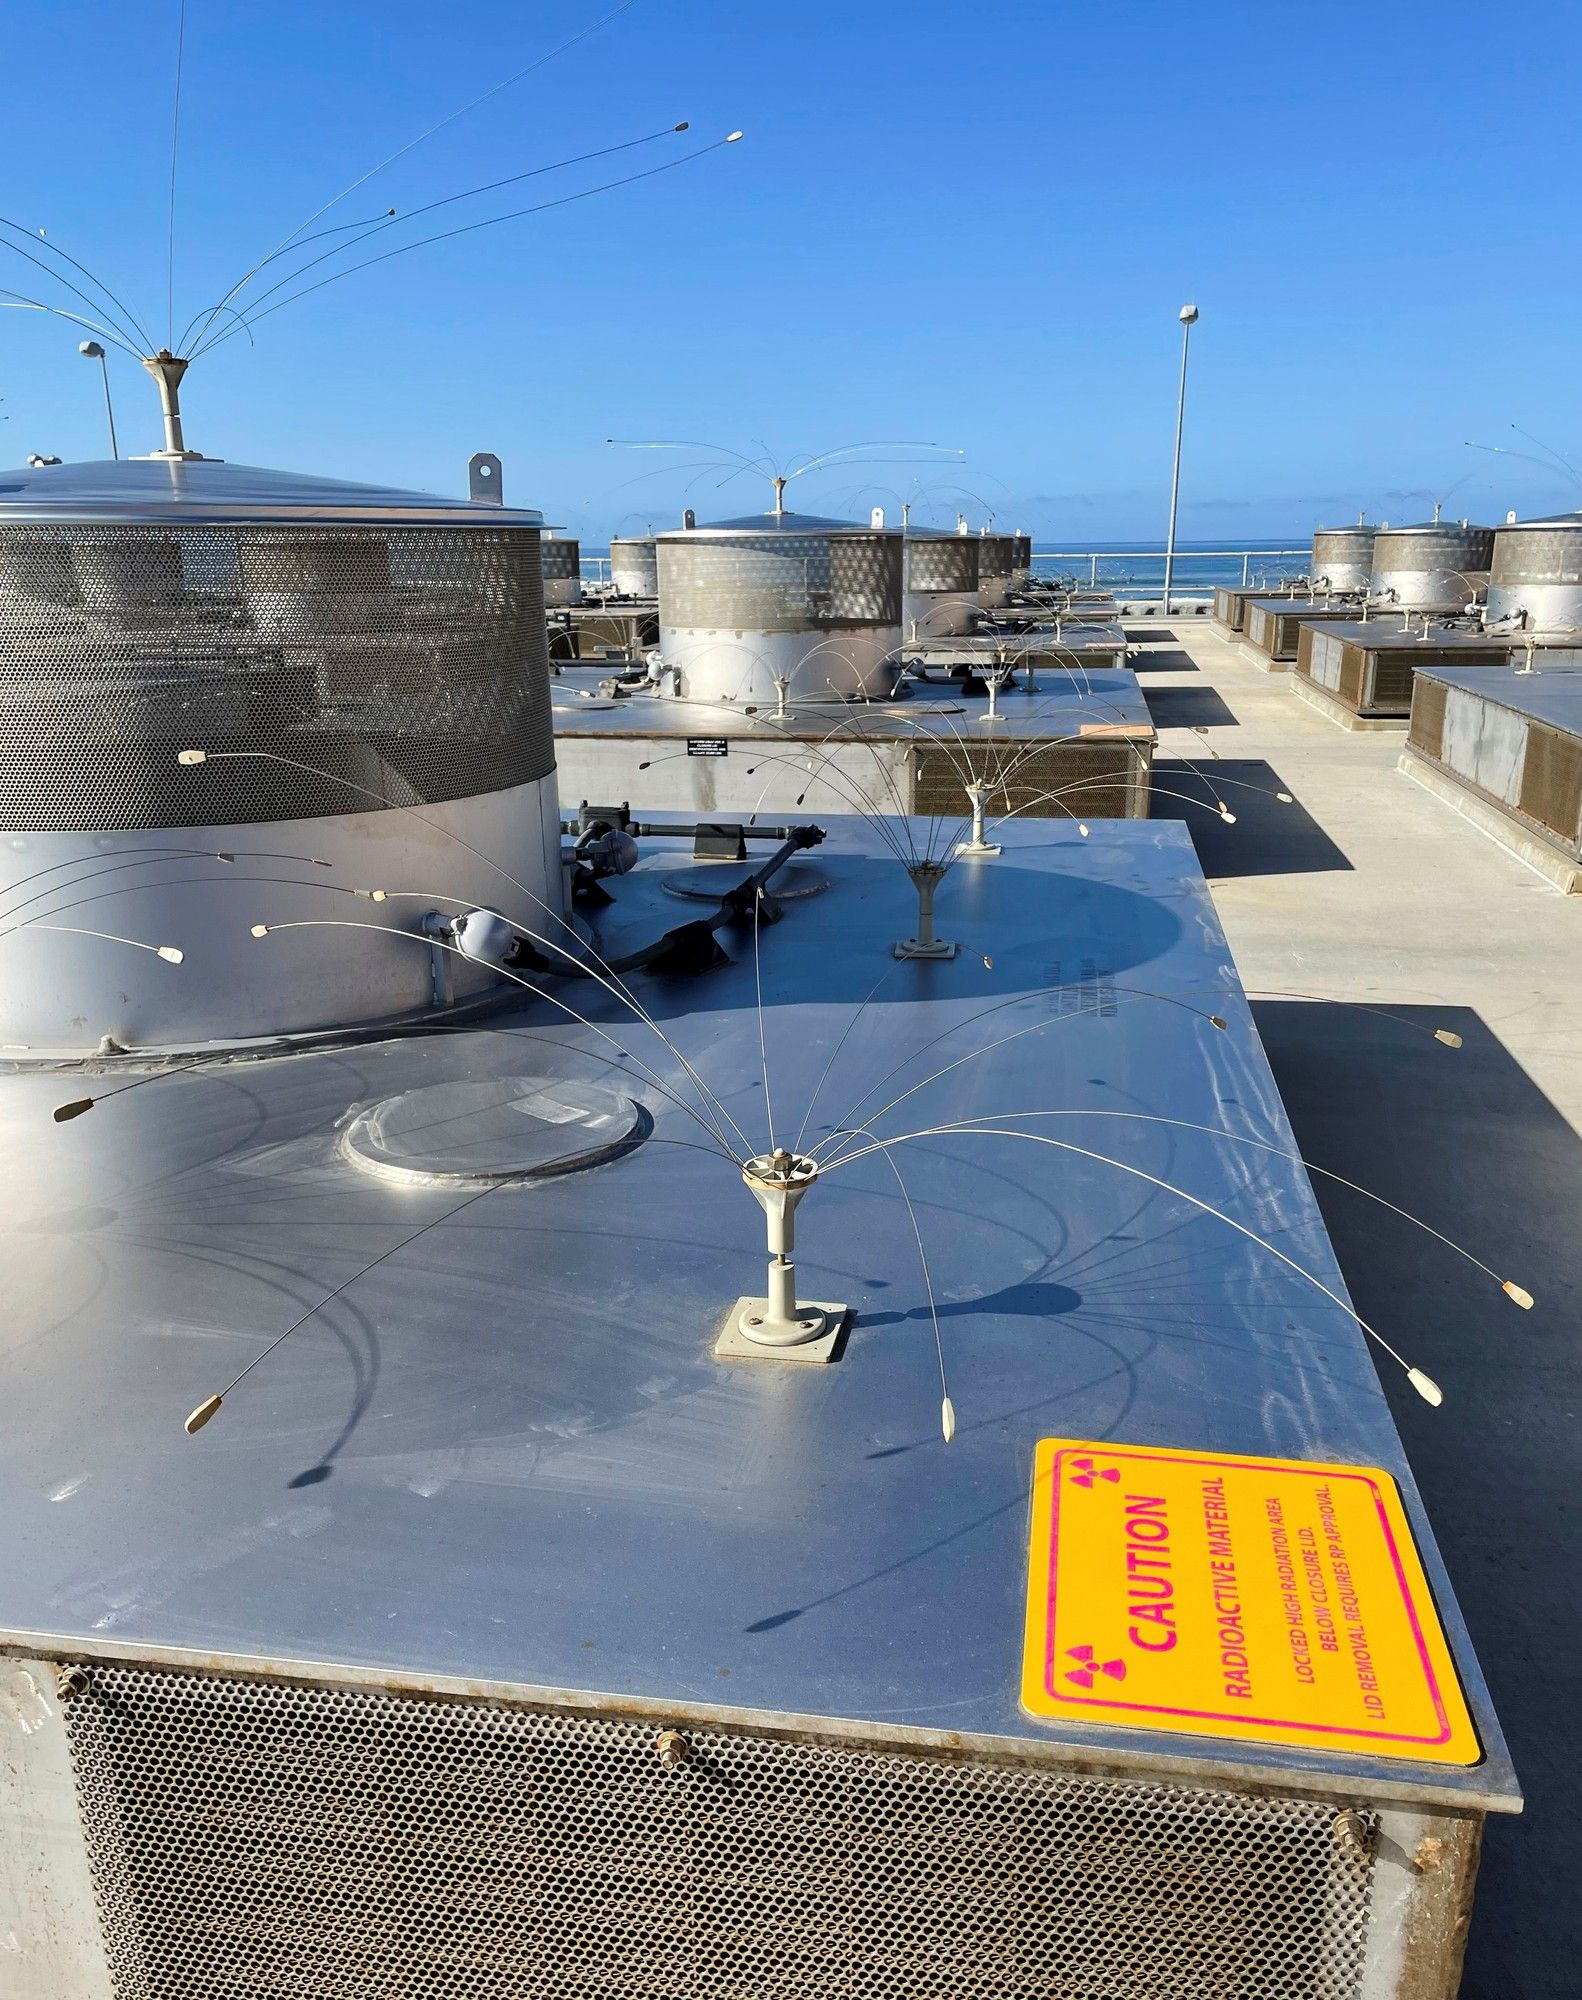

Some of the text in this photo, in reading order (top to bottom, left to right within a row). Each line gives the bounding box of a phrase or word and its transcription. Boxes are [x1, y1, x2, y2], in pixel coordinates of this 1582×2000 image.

[1124, 1494, 1178, 1653] CAUTION
[1202, 1476, 1253, 1699] RADIOACTIVE MATERIAL
[1266, 1497, 1316, 1685] LOCKED HIGH RADIATION AREA
[1298, 1527, 1340, 1653] BELOW CLOSURE LID.
[1318, 1484, 1386, 1720] LID REMOVAL REQUIRES RP APPROVAL.
